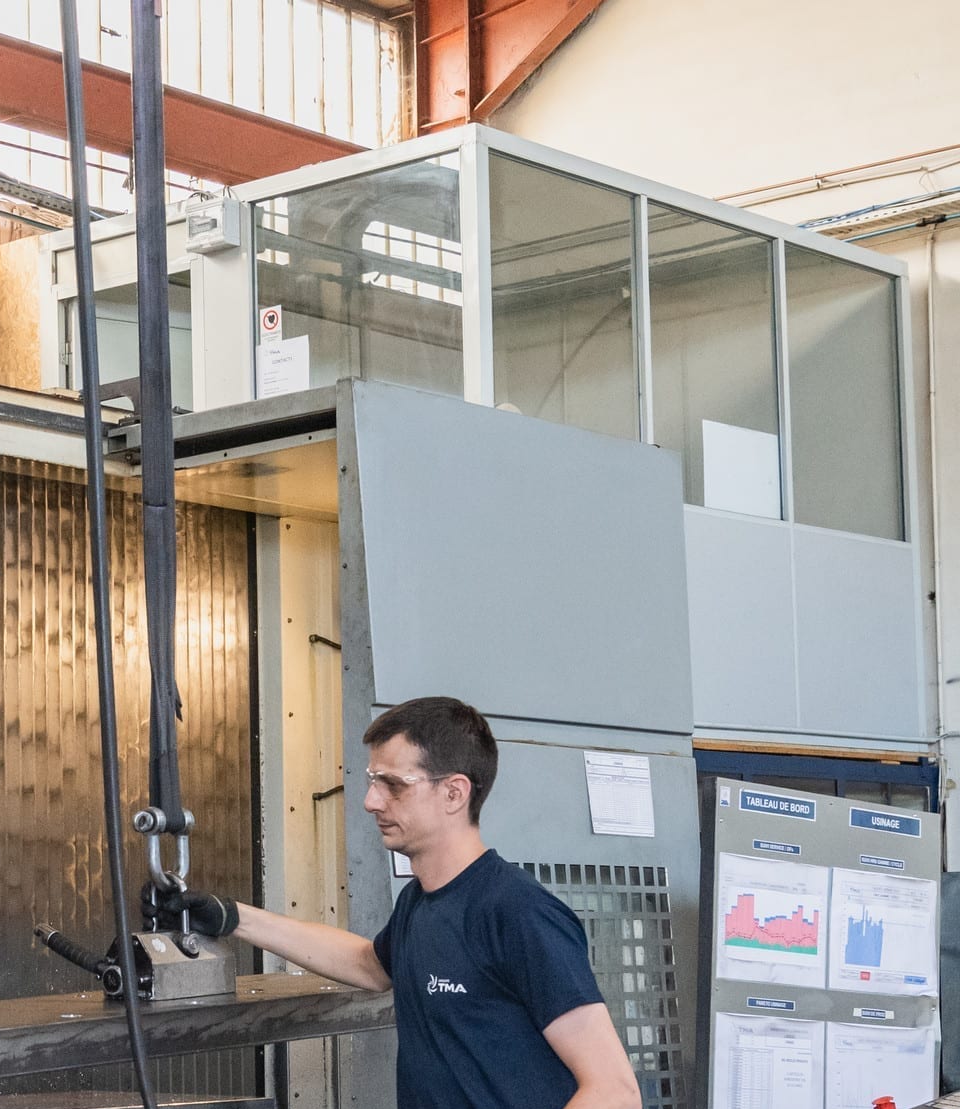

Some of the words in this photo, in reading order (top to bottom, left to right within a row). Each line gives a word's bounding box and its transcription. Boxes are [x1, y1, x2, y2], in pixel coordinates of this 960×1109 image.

[746, 796, 778, 809] TABLEAU
[779, 801, 789, 811] DE
[790, 804, 810, 814] BORD
[871, 816, 900, 829] USINAGE
[438, 983, 467, 993] TMA
